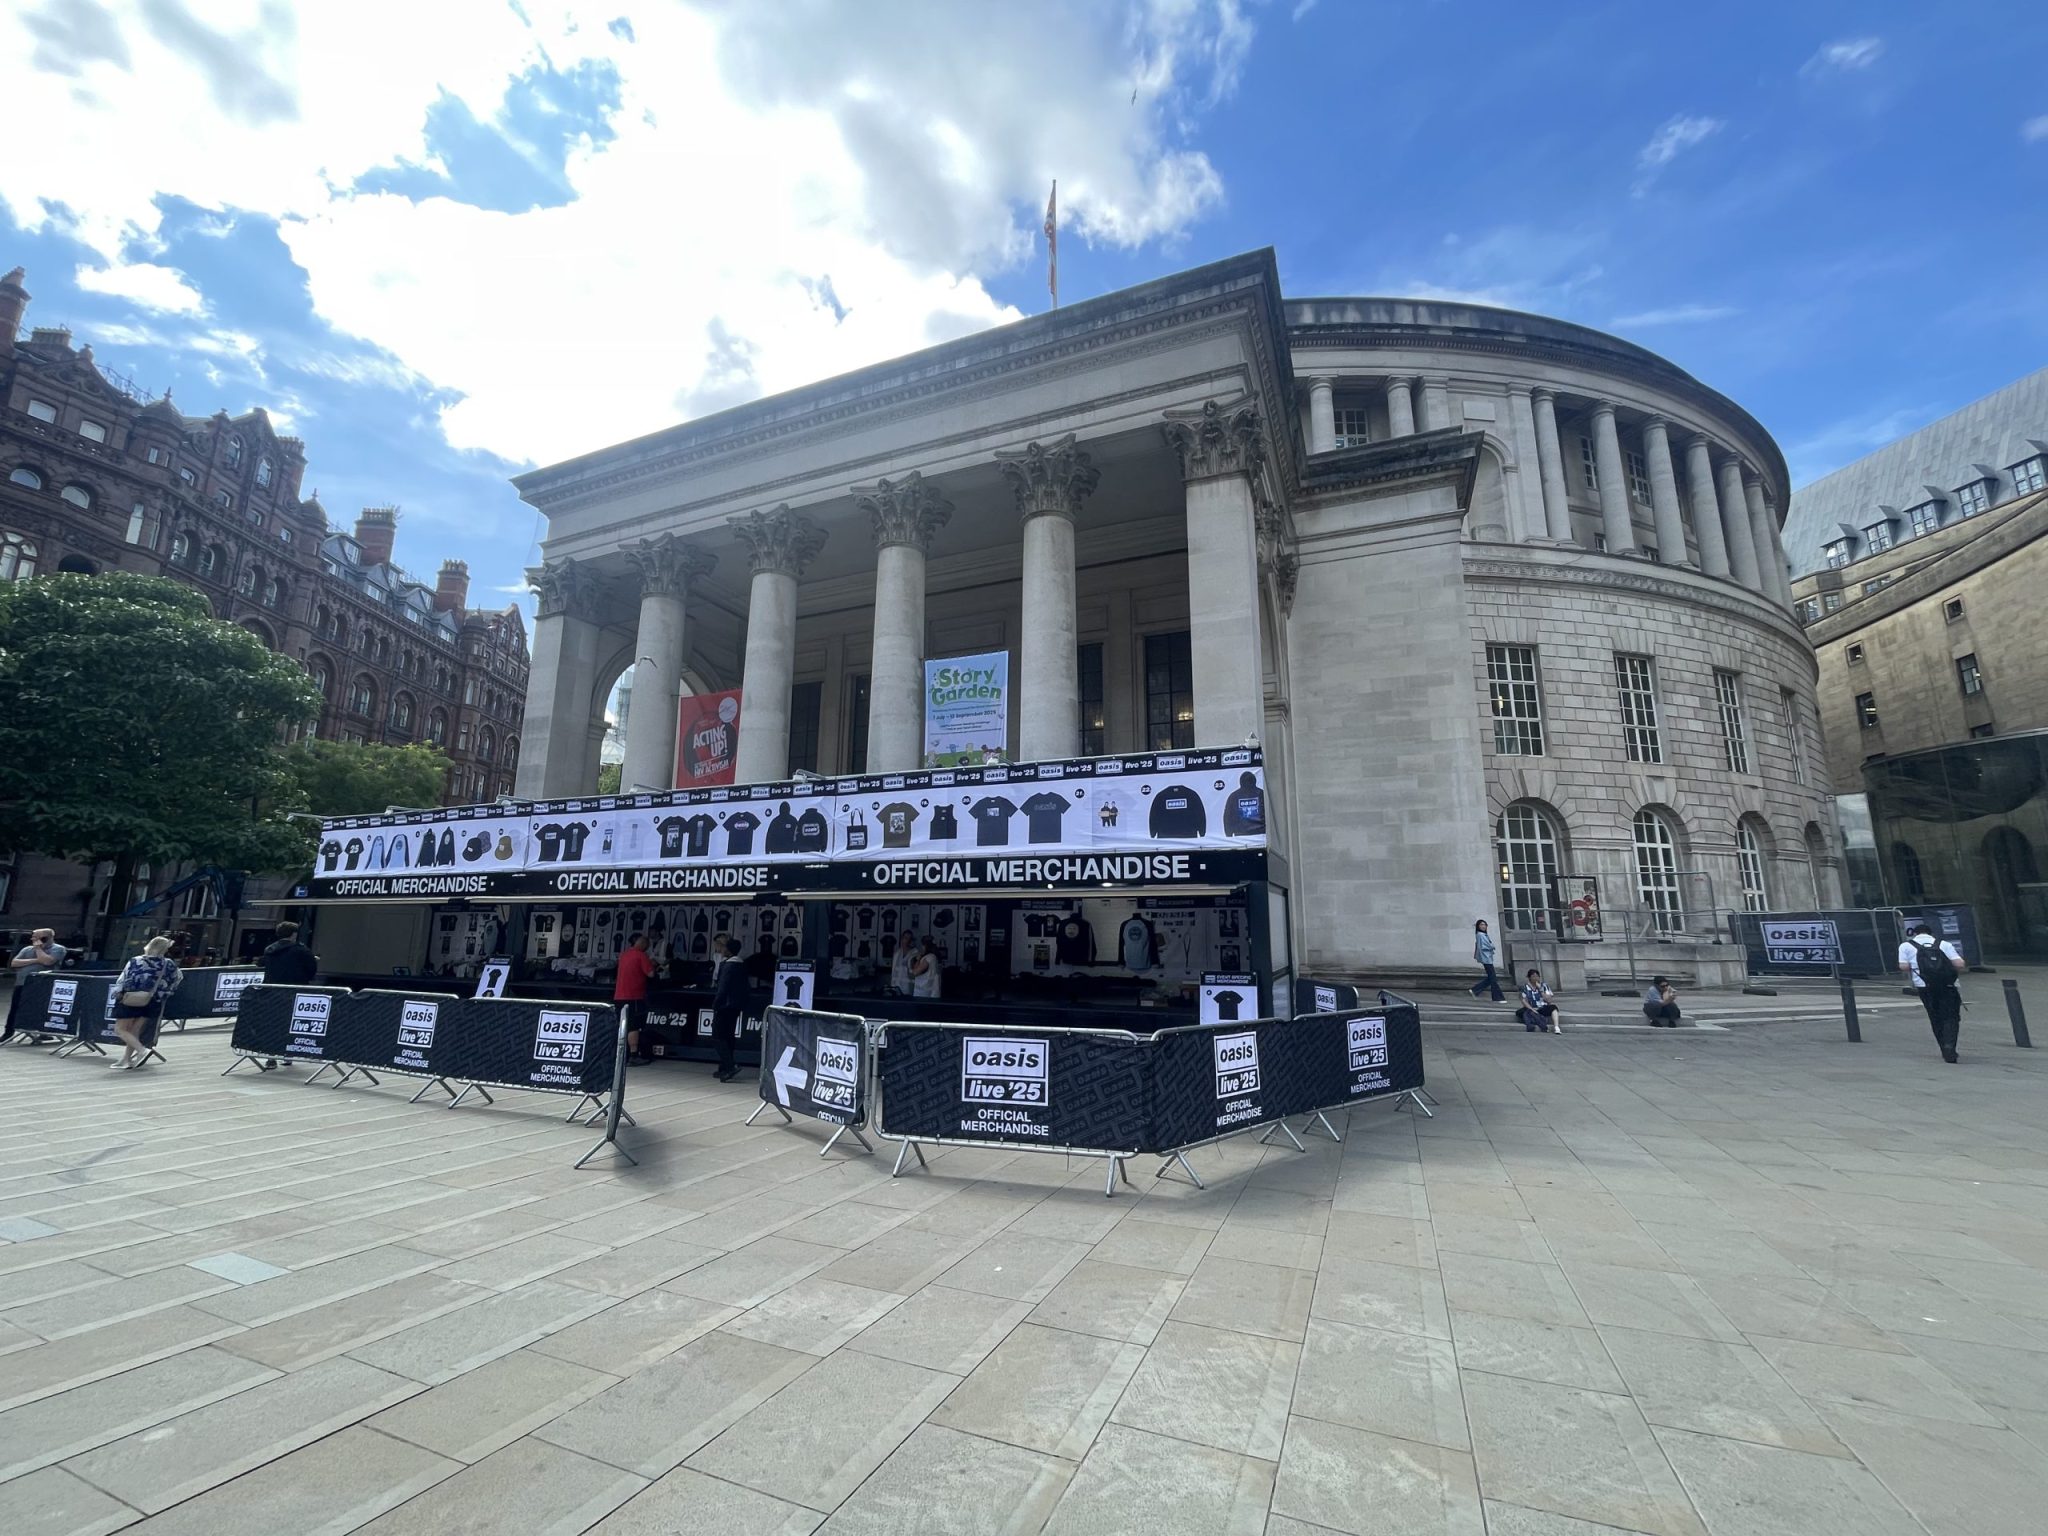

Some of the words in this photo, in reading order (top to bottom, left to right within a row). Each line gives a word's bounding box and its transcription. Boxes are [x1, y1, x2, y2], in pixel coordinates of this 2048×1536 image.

[939, 664, 997, 687] Story
[932, 684, 1002, 706] Garden
[693, 724, 727, 749] ACTING
[710, 739, 728, 757] UP!
[1041, 766, 1061, 775] oasis
[1098, 763, 1120, 771] oasis
[1160, 759, 1182, 767] oasis
[1224, 754, 1248, 762] oasis
[350, 846, 359, 854] 25
[874, 862, 979, 885] OFFICIAL
[986, 855, 1191, 882] MERCHANDISE
[336, 880, 388, 895] OFFICIAL
[391, 876, 488, 894] MERCHANDISE
[557, 872, 629, 890] OFFICIAL
[634, 867, 769, 889] MERCHANDISE
[1771, 927, 1830, 940] oasis
[1774, 949, 1805, 961] live
[223, 976, 263, 985] oasis
[298, 1000, 327, 1013] oasis
[1318, 993, 1334, 1005] oasis
[406, 1009, 433, 1023] oasis
[646, 1011, 666, 1025] live
[669, 1013, 688, 1027] '25
[293, 1020, 309, 1031] live
[310, 1021, 324, 1033] '25
[543, 1019, 583, 1034] oasis
[1352, 1024, 1382, 1041] oasis
[400, 1030, 416, 1042] live
[417, 1032, 431, 1044] '25
[402, 1049, 423, 1059] OFFICIAL
[538, 1043, 560, 1057] live
[561, 1044, 581, 1059] '25
[972, 1048, 1040, 1069] oasis
[1220, 1041, 1253, 1063] oasis
[1353, 1053, 1370, 1067] live
[1370, 1049, 1385, 1063] '25
[394, 1056, 430, 1068] MERCHANDISE
[541, 1064, 573, 1075] OFFICIAL
[820, 1051, 853, 1073] oasis
[530, 1072, 582, 1085] MERCHANDISE
[1221, 1076, 1240, 1094] live
[1240, 1071, 1256, 1089] '25
[1358, 1071, 1383, 1083] OFFICIAL
[814, 1081, 834, 1101] live
[834, 1085, 853, 1106] '25
[969, 1080, 1006, 1099] live
[1009, 1082, 1041, 1101] '25
[1351, 1079, 1391, 1094] MERCHANDISE
[1226, 1098, 1253, 1113] OFFICIAL
[978, 1109, 1032, 1122] OFFICIAL
[1217, 1106, 1263, 1127] MERCHANDISE
[961, 1120, 1049, 1136] MERCHANDISE
